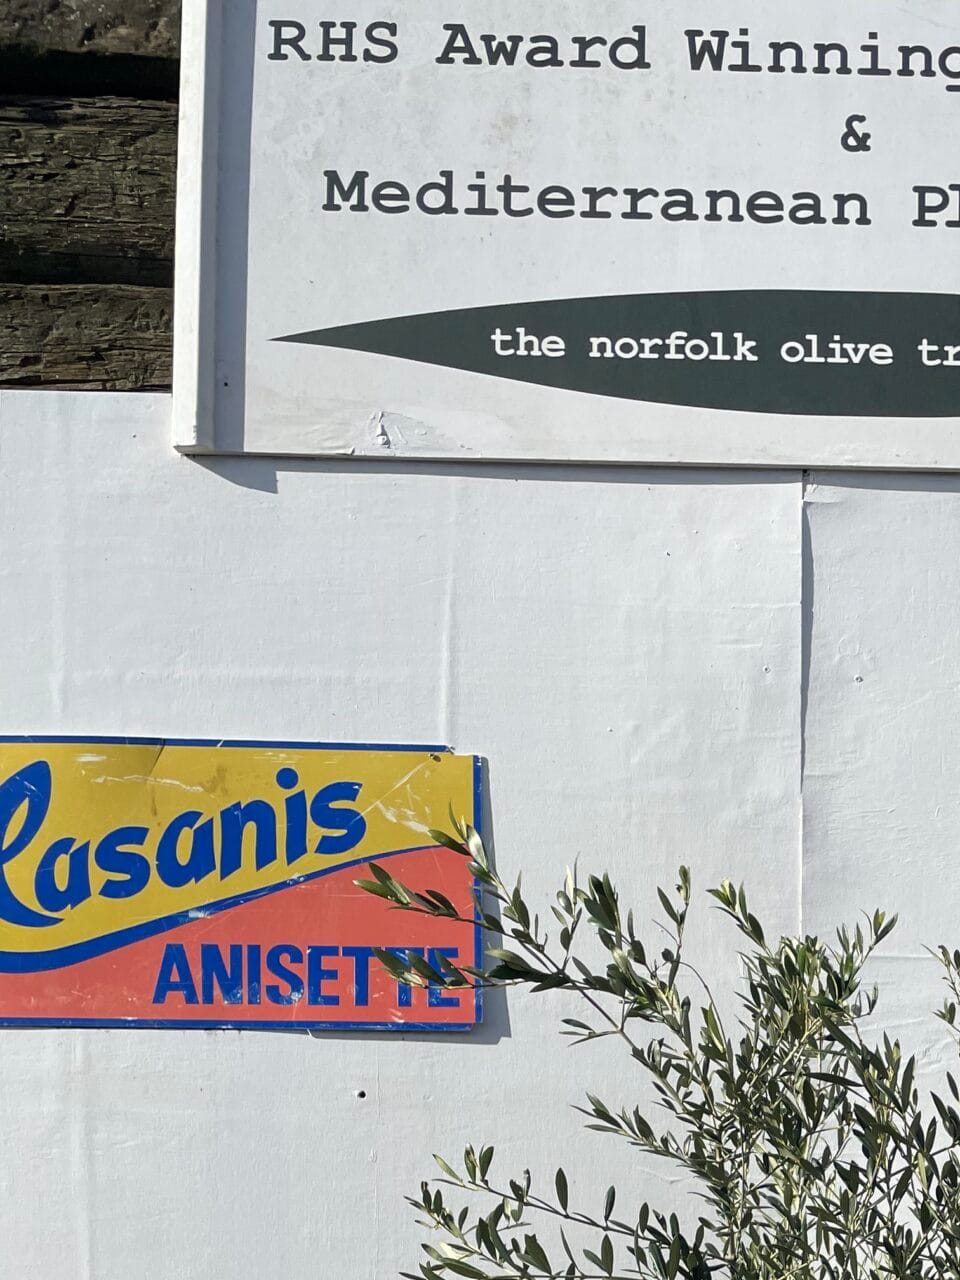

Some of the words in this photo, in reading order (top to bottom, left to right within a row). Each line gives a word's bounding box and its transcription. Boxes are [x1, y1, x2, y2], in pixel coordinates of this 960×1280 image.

[267, 19, 399, 64] RHS
[435, 23, 652, 70] Award
[840, 114, 872, 153] &
[321, 169, 872, 226] Mediterranean
[490, 327, 566, 358] the
[588, 330, 759, 362] norfolk
[780, 334, 894, 365] olive
